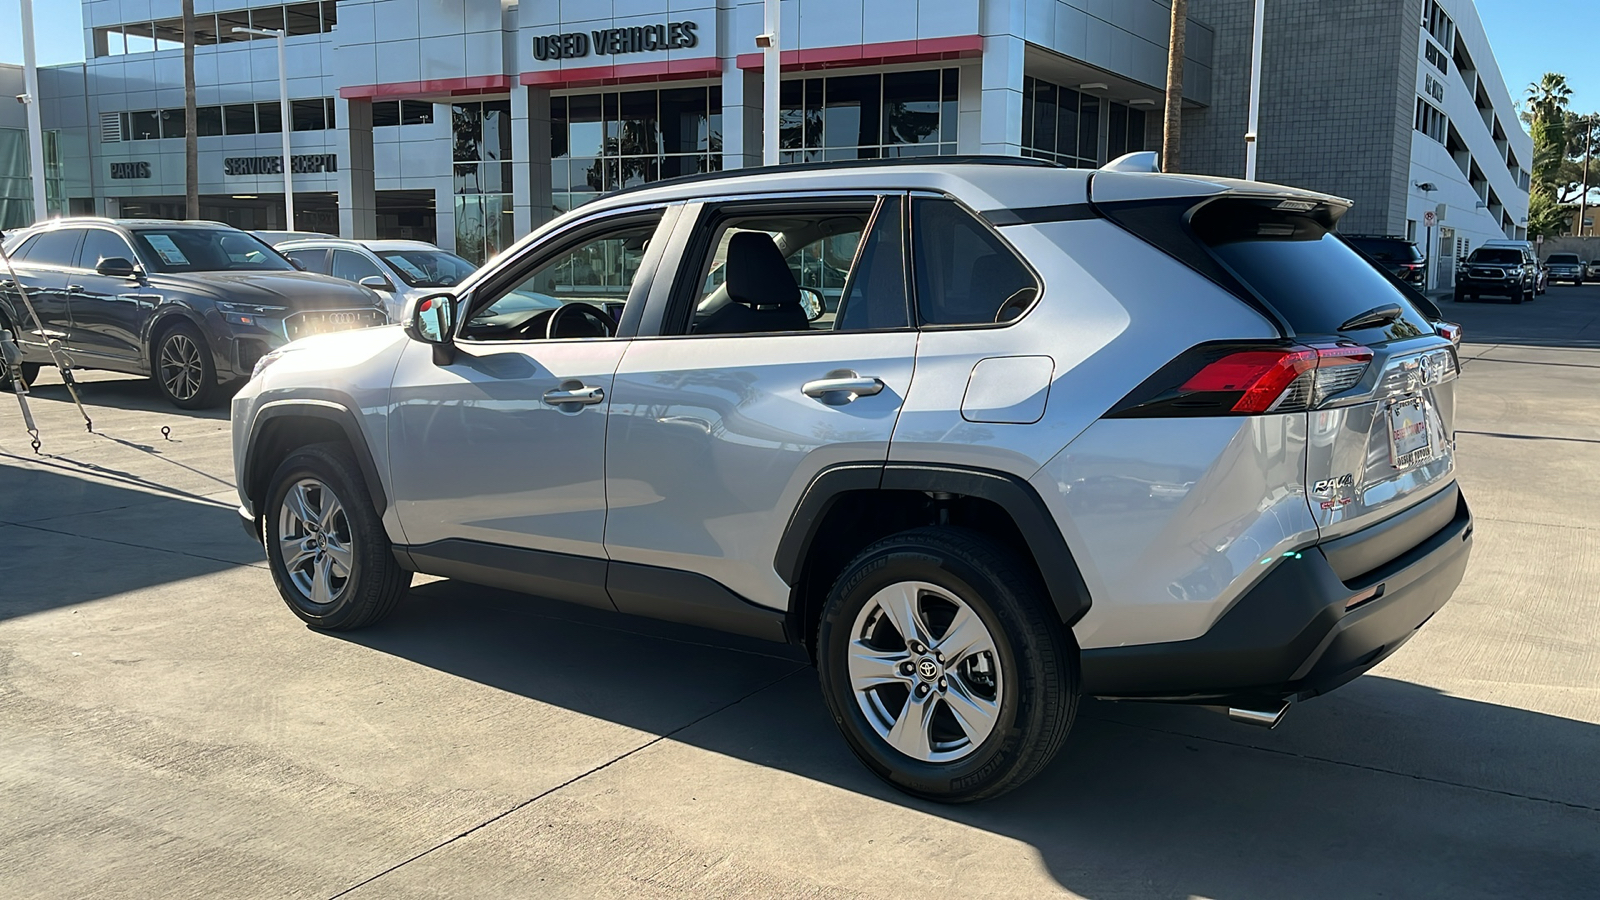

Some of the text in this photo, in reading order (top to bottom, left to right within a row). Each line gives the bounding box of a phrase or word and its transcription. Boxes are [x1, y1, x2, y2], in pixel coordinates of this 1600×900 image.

[532, 20, 699, 61] USED VEHICLES
[110, 161, 152, 179] PARTS
[224, 153, 338, 175] SERVICE ECEPTI
[1312, 473, 1352, 493] RAV4
[840, 557, 888, 600] MICHELIN
[951, 751, 1005, 791] MICHELIN
